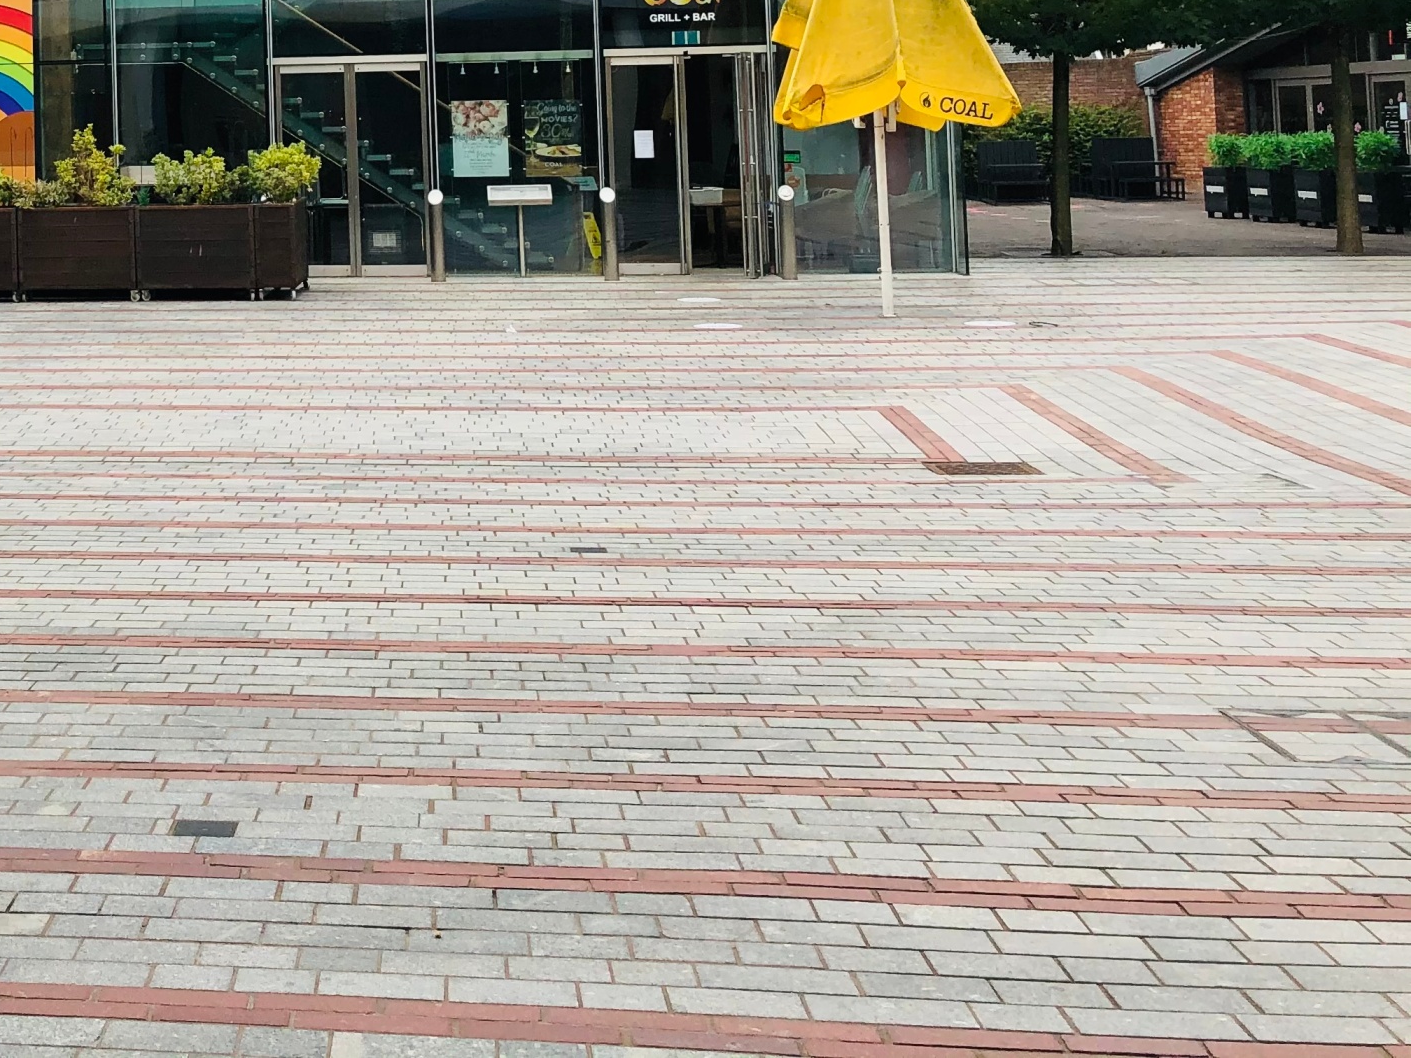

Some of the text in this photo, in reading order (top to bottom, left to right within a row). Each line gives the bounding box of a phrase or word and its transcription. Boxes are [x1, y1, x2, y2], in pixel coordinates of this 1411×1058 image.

[649, 13, 681, 23] GRILL
[692, 12, 716, 22] BAR
[940, 96, 993, 120] COAL
